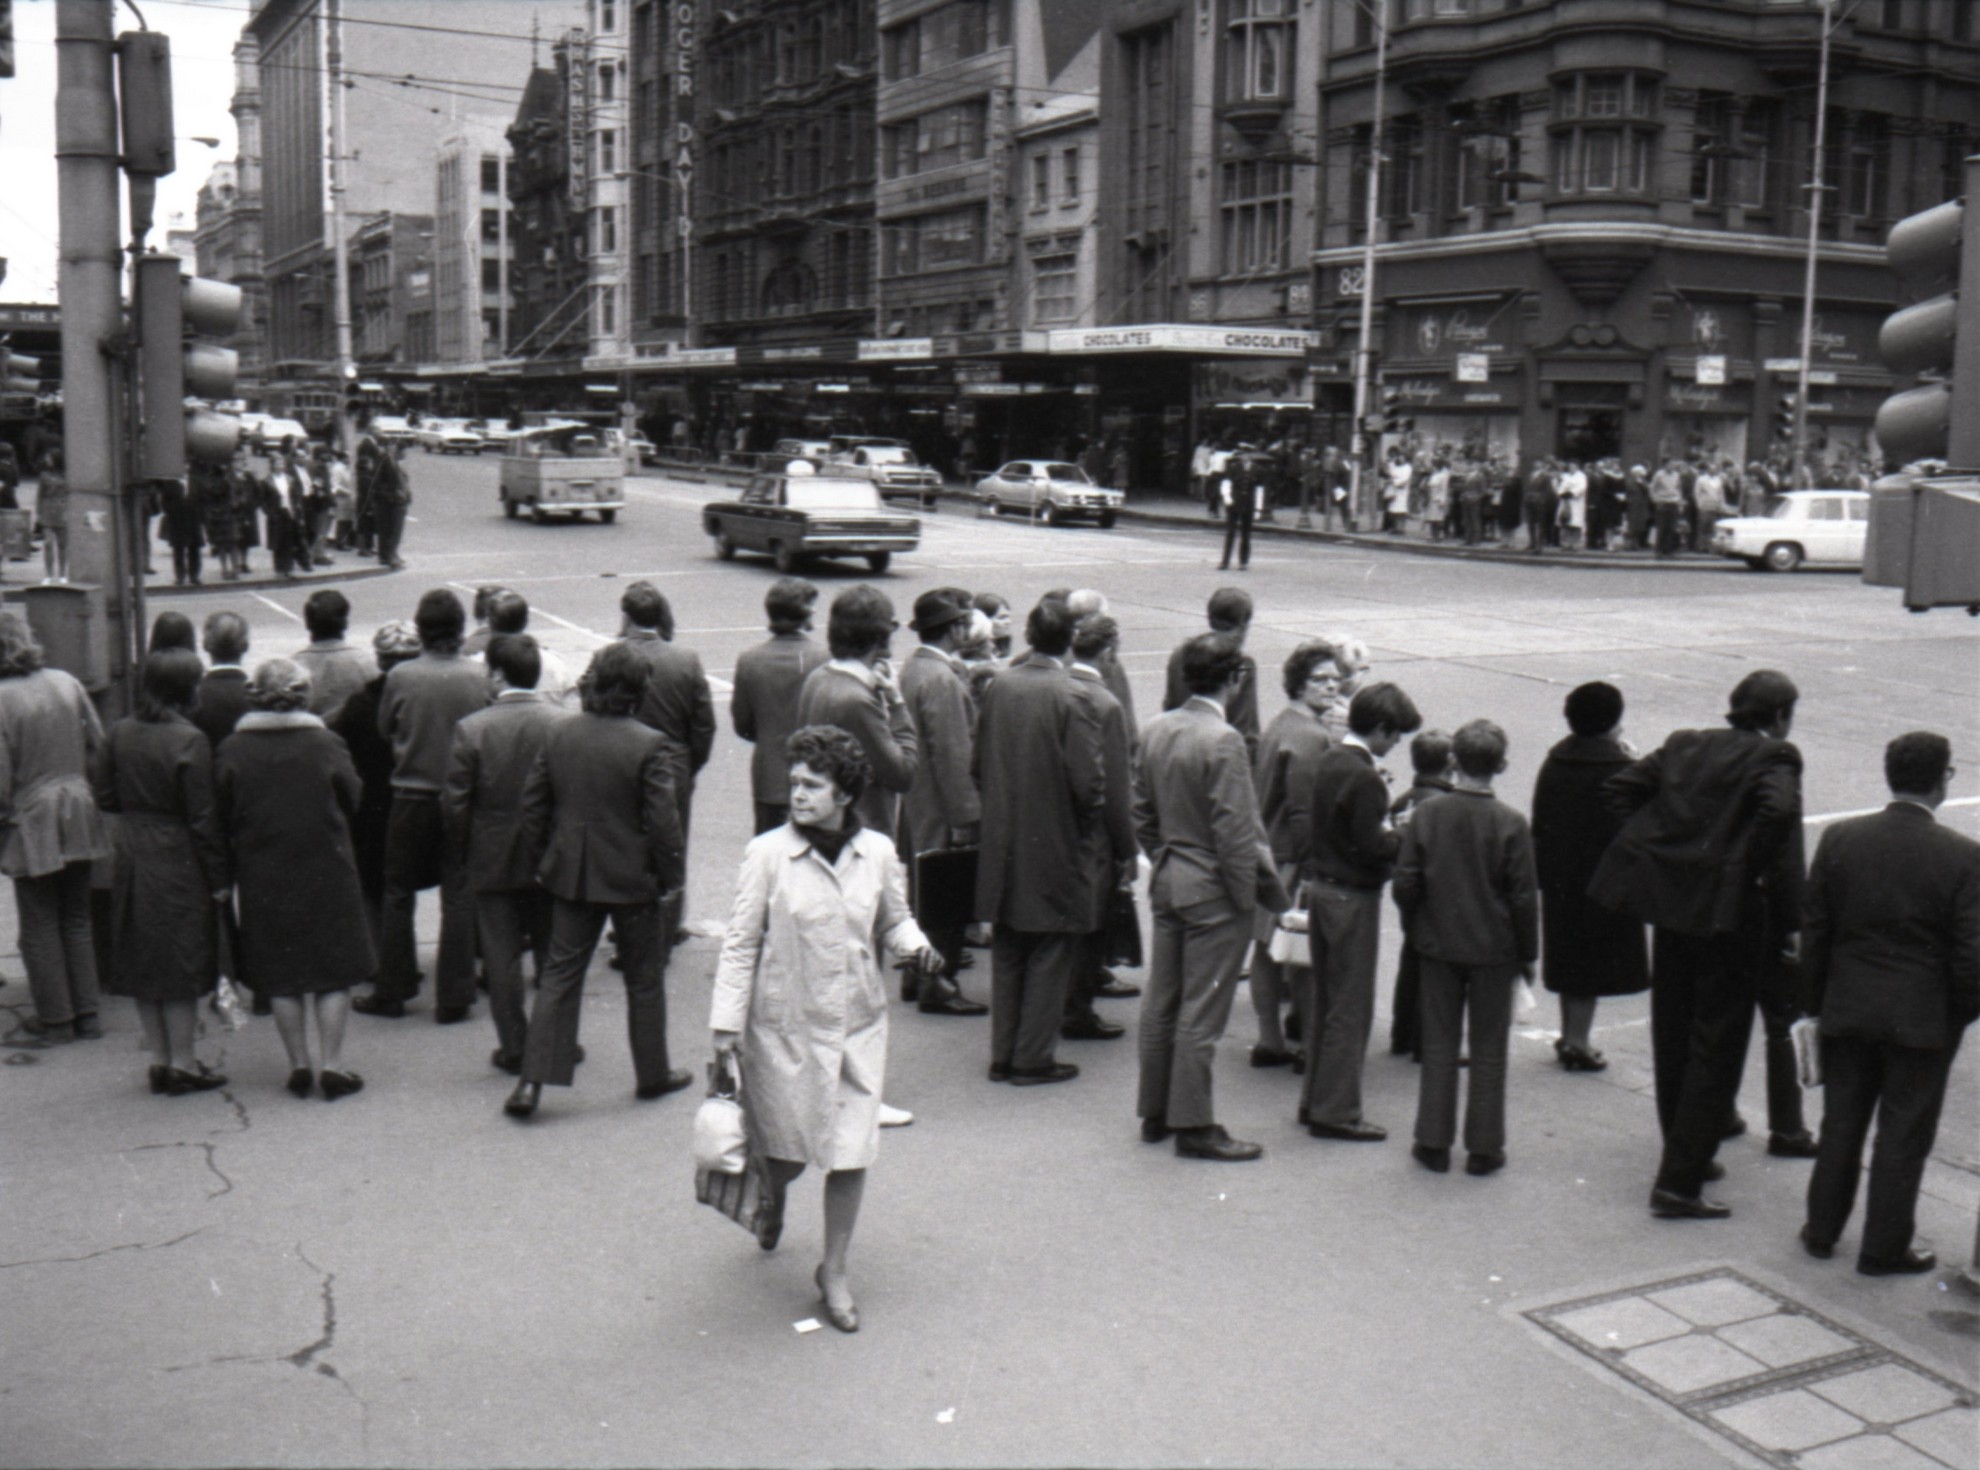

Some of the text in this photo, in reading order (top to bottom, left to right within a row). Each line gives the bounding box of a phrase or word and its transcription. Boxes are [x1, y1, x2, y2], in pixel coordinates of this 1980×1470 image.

[1340, 267, 1364, 295] 82
[1084, 332, 1152, 347] CHOCOLATES
[1224, 333, 1309, 349] CHOCOLATES
